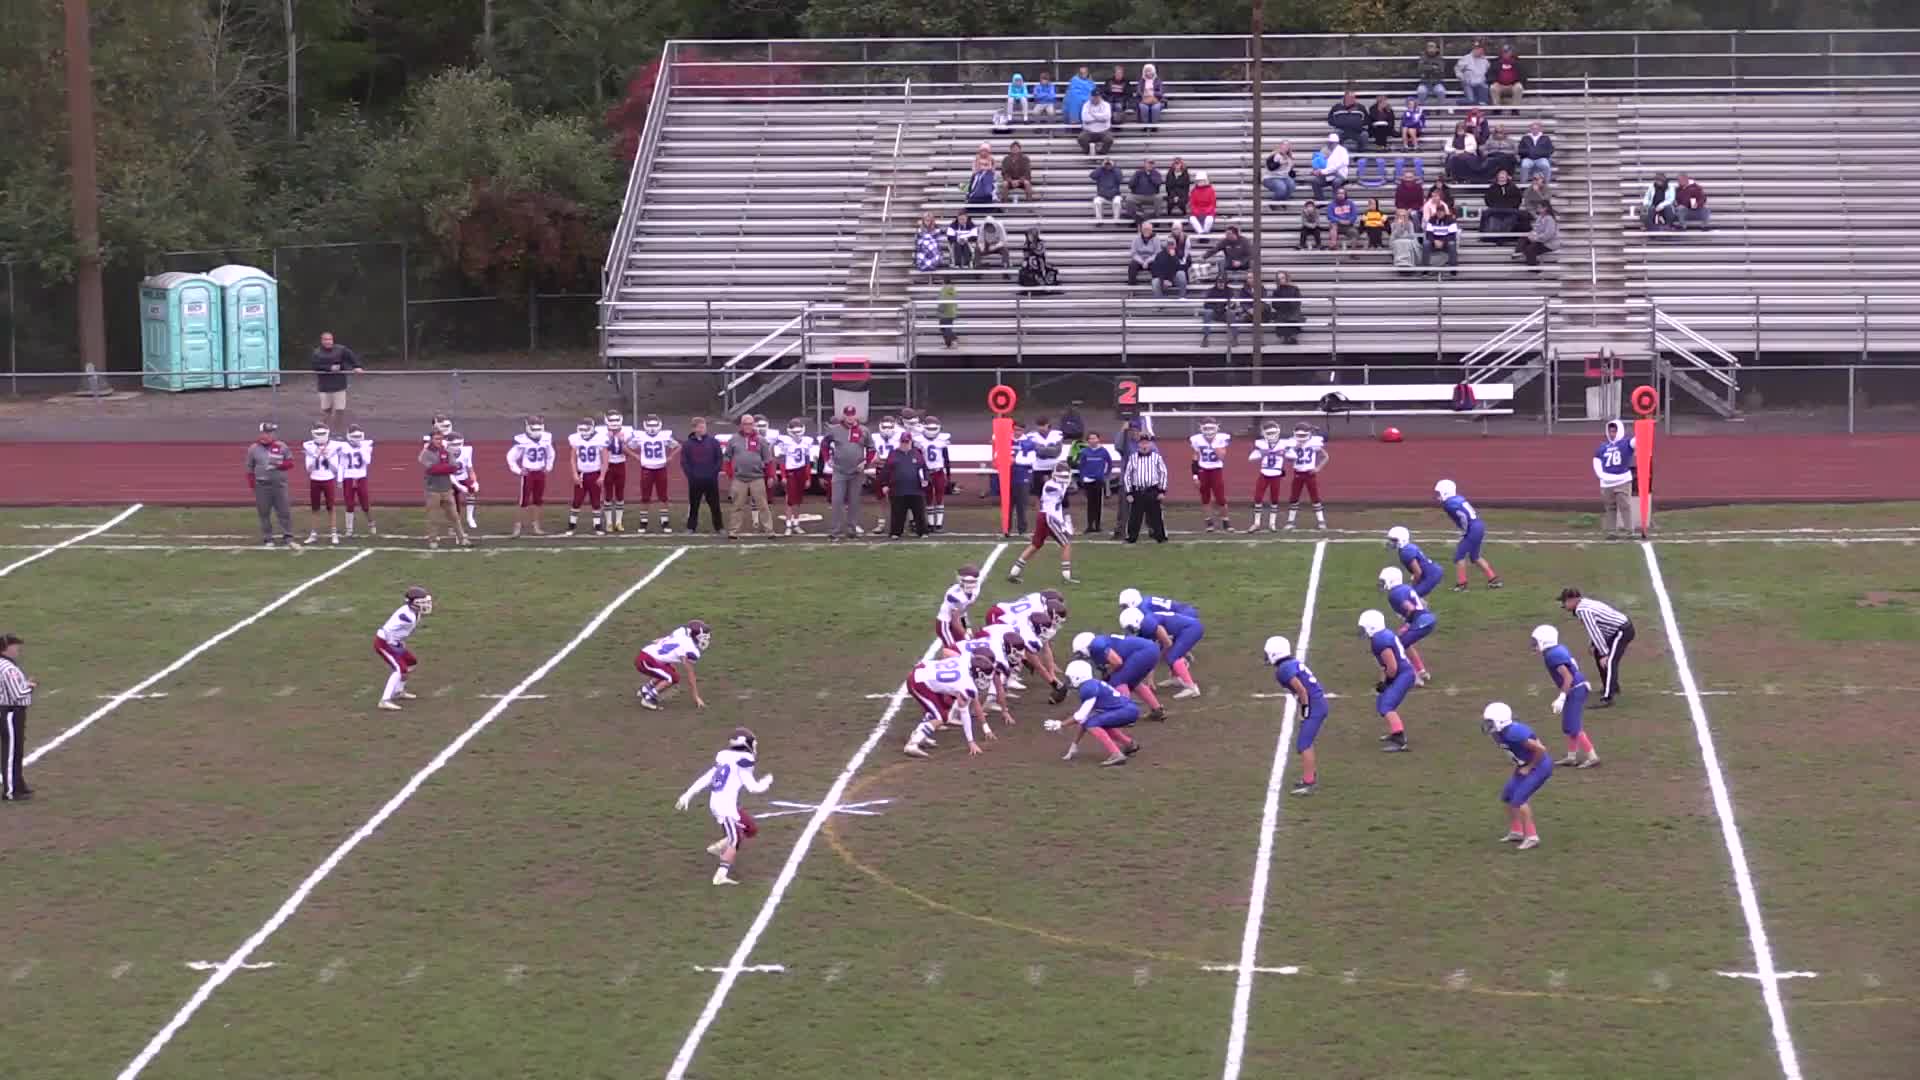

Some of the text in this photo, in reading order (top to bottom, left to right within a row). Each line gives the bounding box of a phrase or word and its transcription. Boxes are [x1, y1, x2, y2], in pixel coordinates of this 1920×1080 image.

[1118, 381, 1137, 404] 2
[527, 447, 546, 462] 33
[644, 441, 663, 459] 62
[927, 445, 937, 462] 6
[1603, 450, 1621, 467] 78
[345, 452, 364, 469] 13
